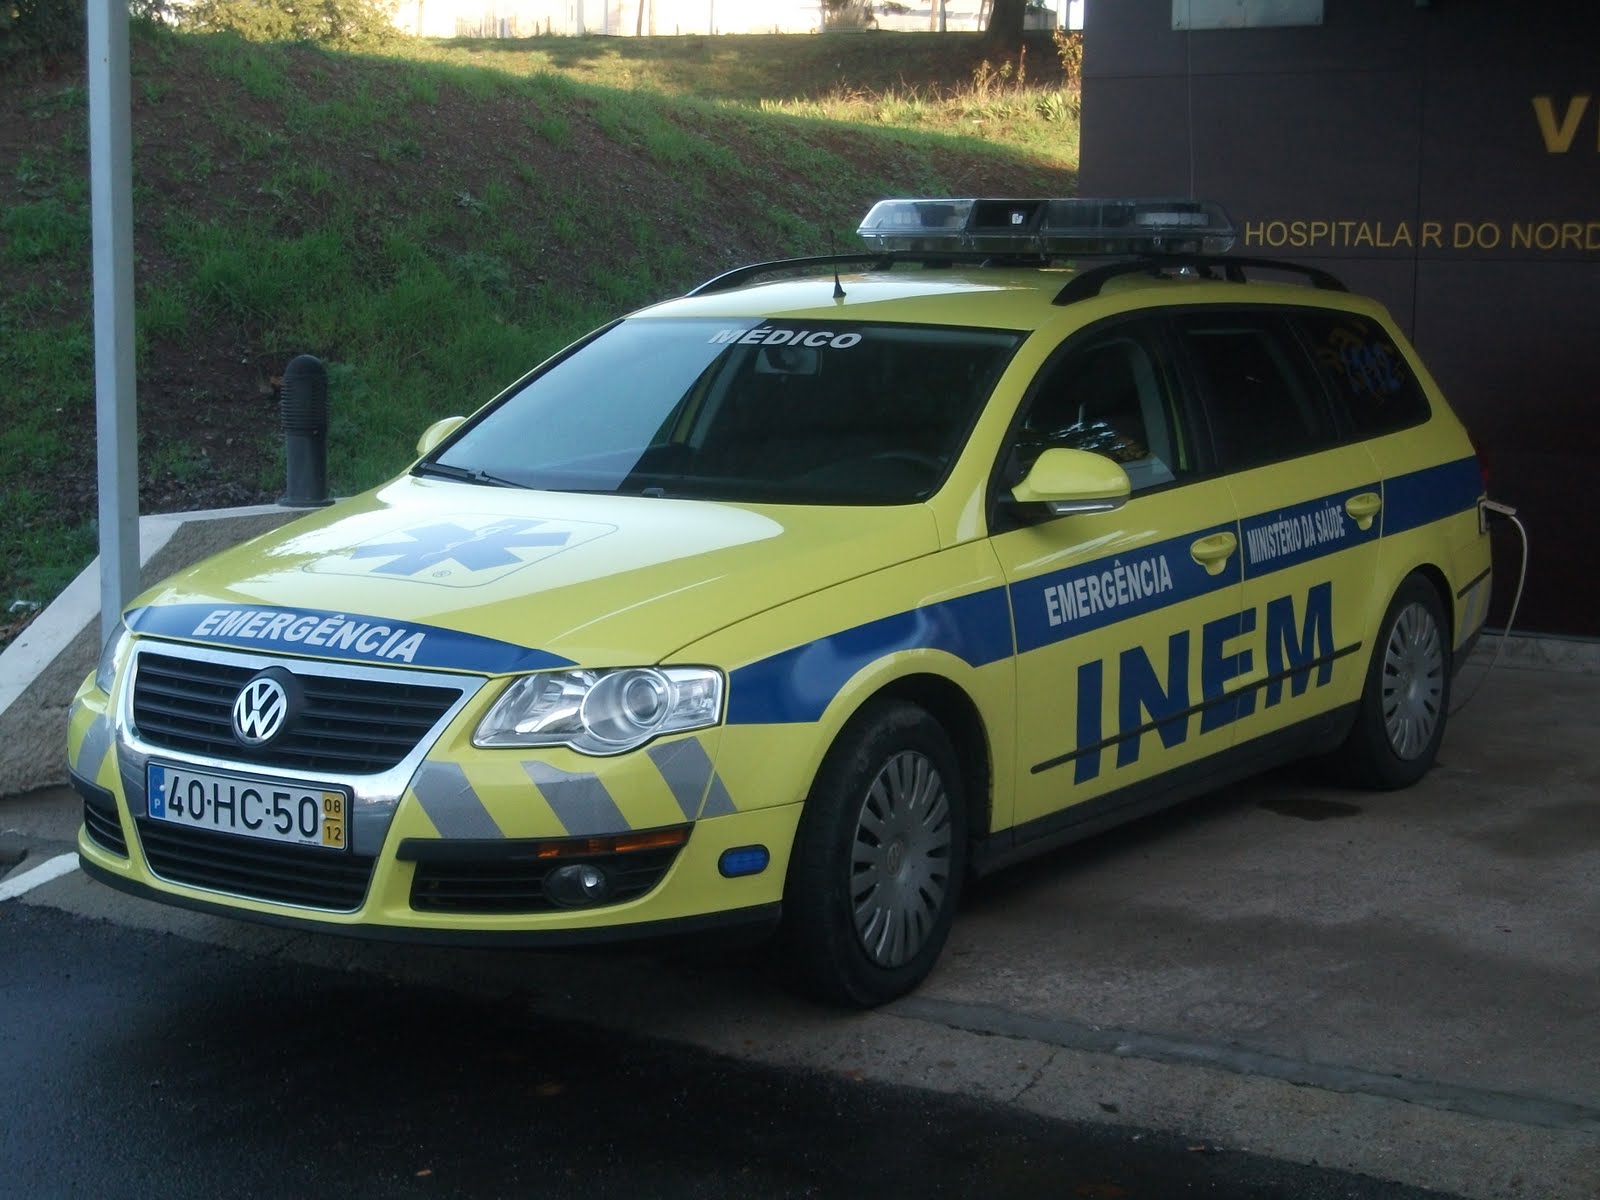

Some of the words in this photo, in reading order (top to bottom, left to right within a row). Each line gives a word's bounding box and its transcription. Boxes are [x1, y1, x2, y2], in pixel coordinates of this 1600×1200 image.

[1532, 94, 1600, 152] V
[1453, 222, 1500, 249] DO
[707, 326, 862, 349] MÉDICO
[1246, 513, 1302, 565] MINISTÉRIO
[1301, 513, 1317, 549] DA
[1314, 500, 1346, 546] SAÚDE
[1044, 560, 1173, 627] EMERGÊNCIA
[191, 609, 426, 664] EMERGÊNCIA
[1073, 580, 1335, 786] INEM
[154, 798, 161, 810] P
[323, 798, 341, 813] 08
[326, 825, 342, 841] 12
